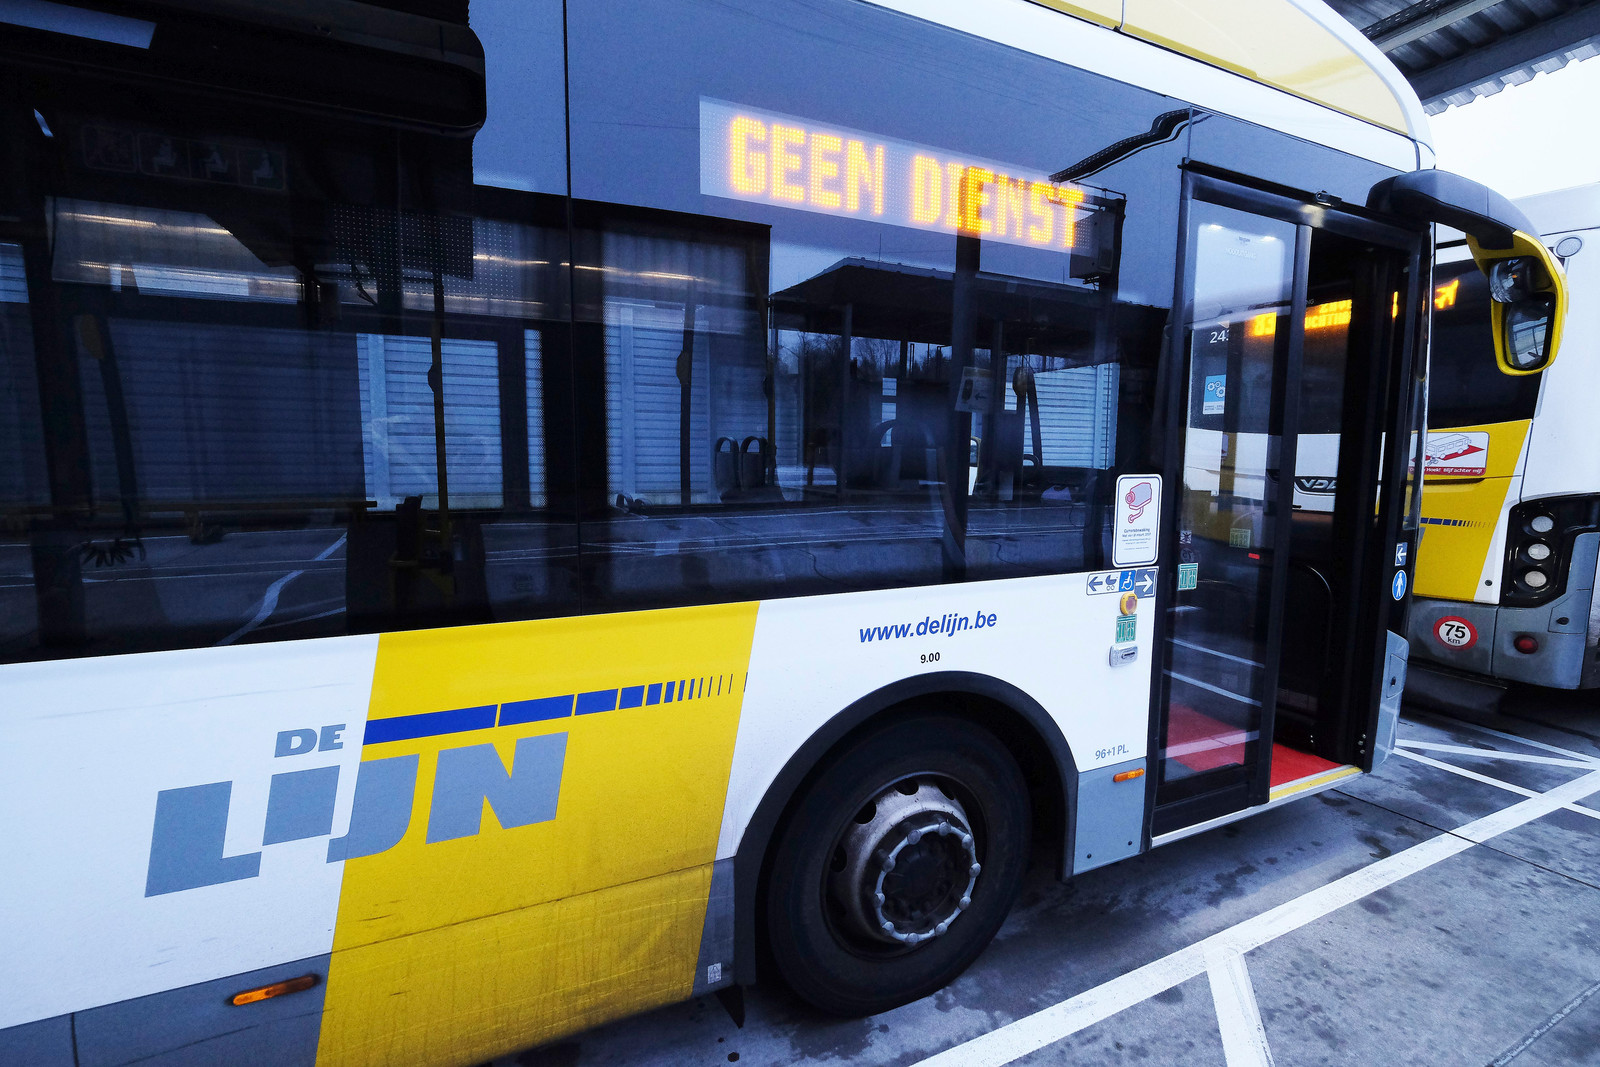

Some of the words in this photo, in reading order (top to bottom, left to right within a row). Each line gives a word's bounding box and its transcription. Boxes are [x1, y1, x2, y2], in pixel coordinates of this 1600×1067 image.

[732, 115, 885, 216] GEEN
[912, 154, 1085, 249] DIENST
[859, 610, 998, 643] www.delijn.be
[1444, 623, 1466, 639] 75
[1447, 637, 1461, 645] km
[920, 651, 941, 664] 9.00
[274, 723, 347, 758] DE
[1095, 746, 1116, 760] 96+1
